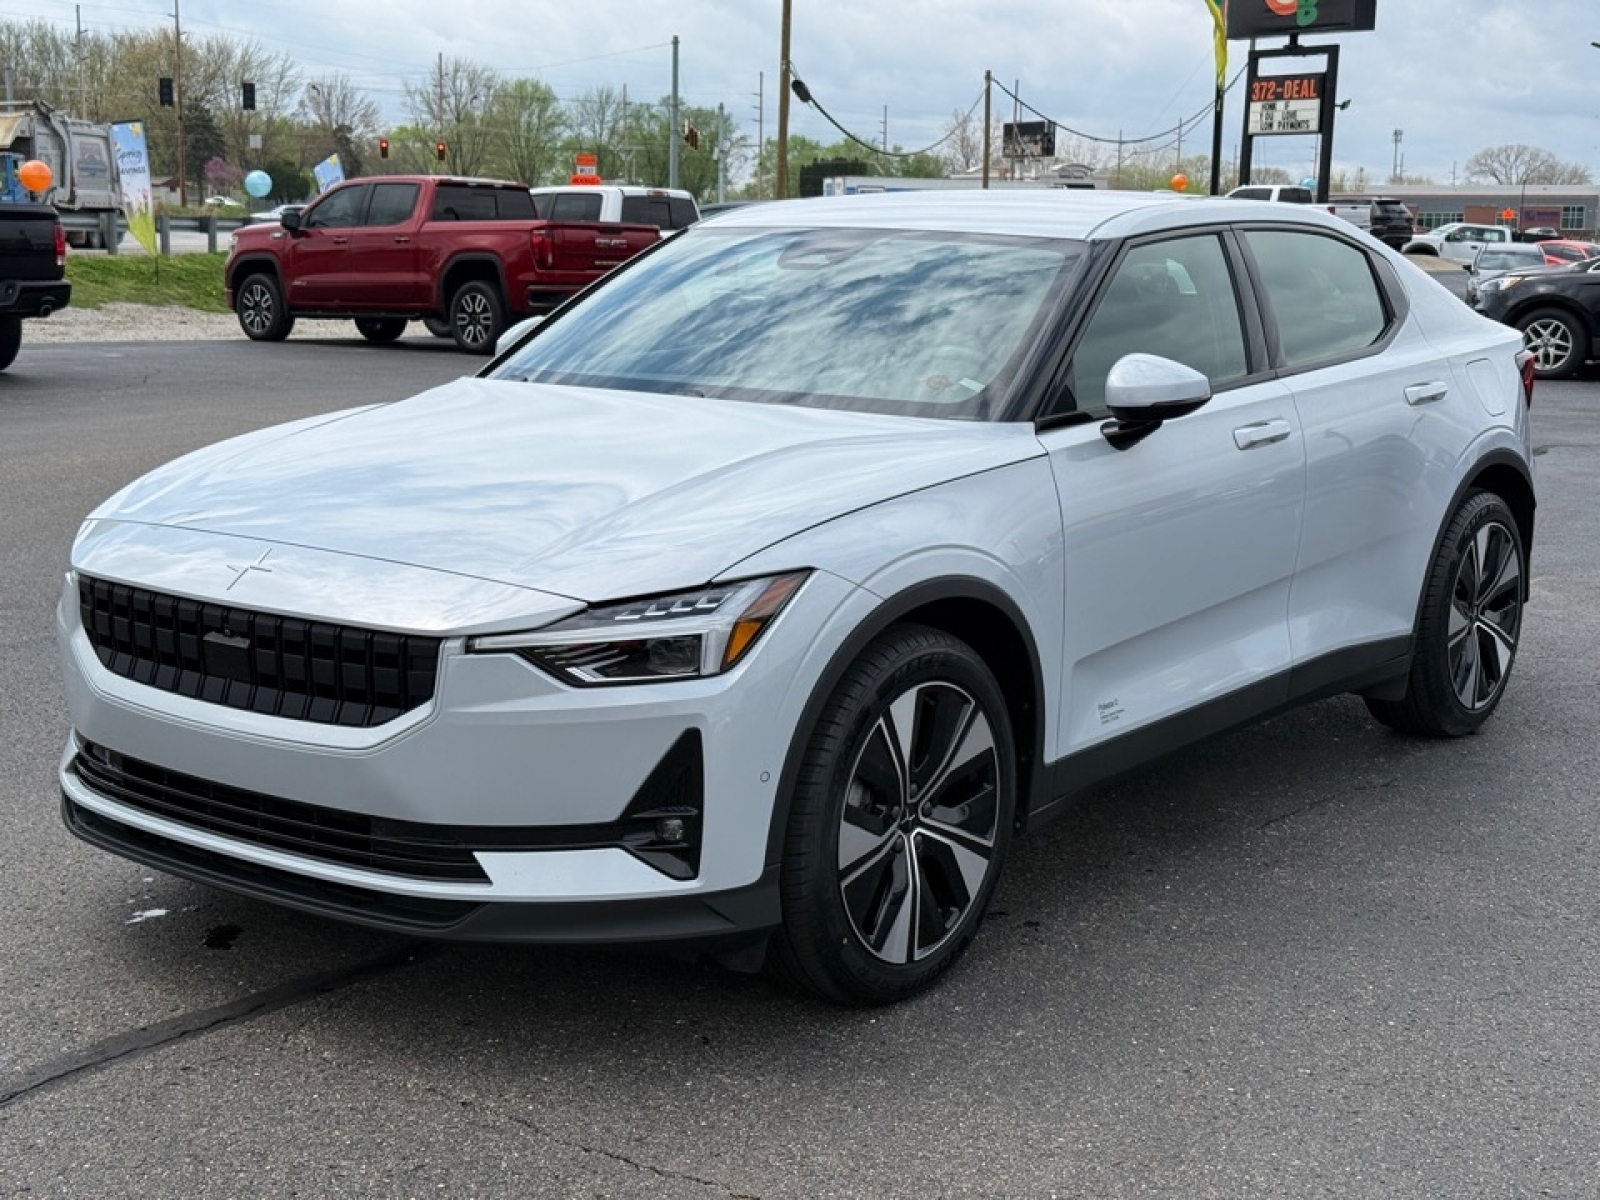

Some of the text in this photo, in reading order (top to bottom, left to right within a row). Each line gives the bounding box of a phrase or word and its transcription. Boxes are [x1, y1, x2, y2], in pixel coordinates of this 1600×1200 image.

[1252, 78, 1317, 101] 372-DEAL
[1260, 110, 1298, 121] YOU LOVE
[1260, 119, 1311, 131] LOW PAYMENTS
